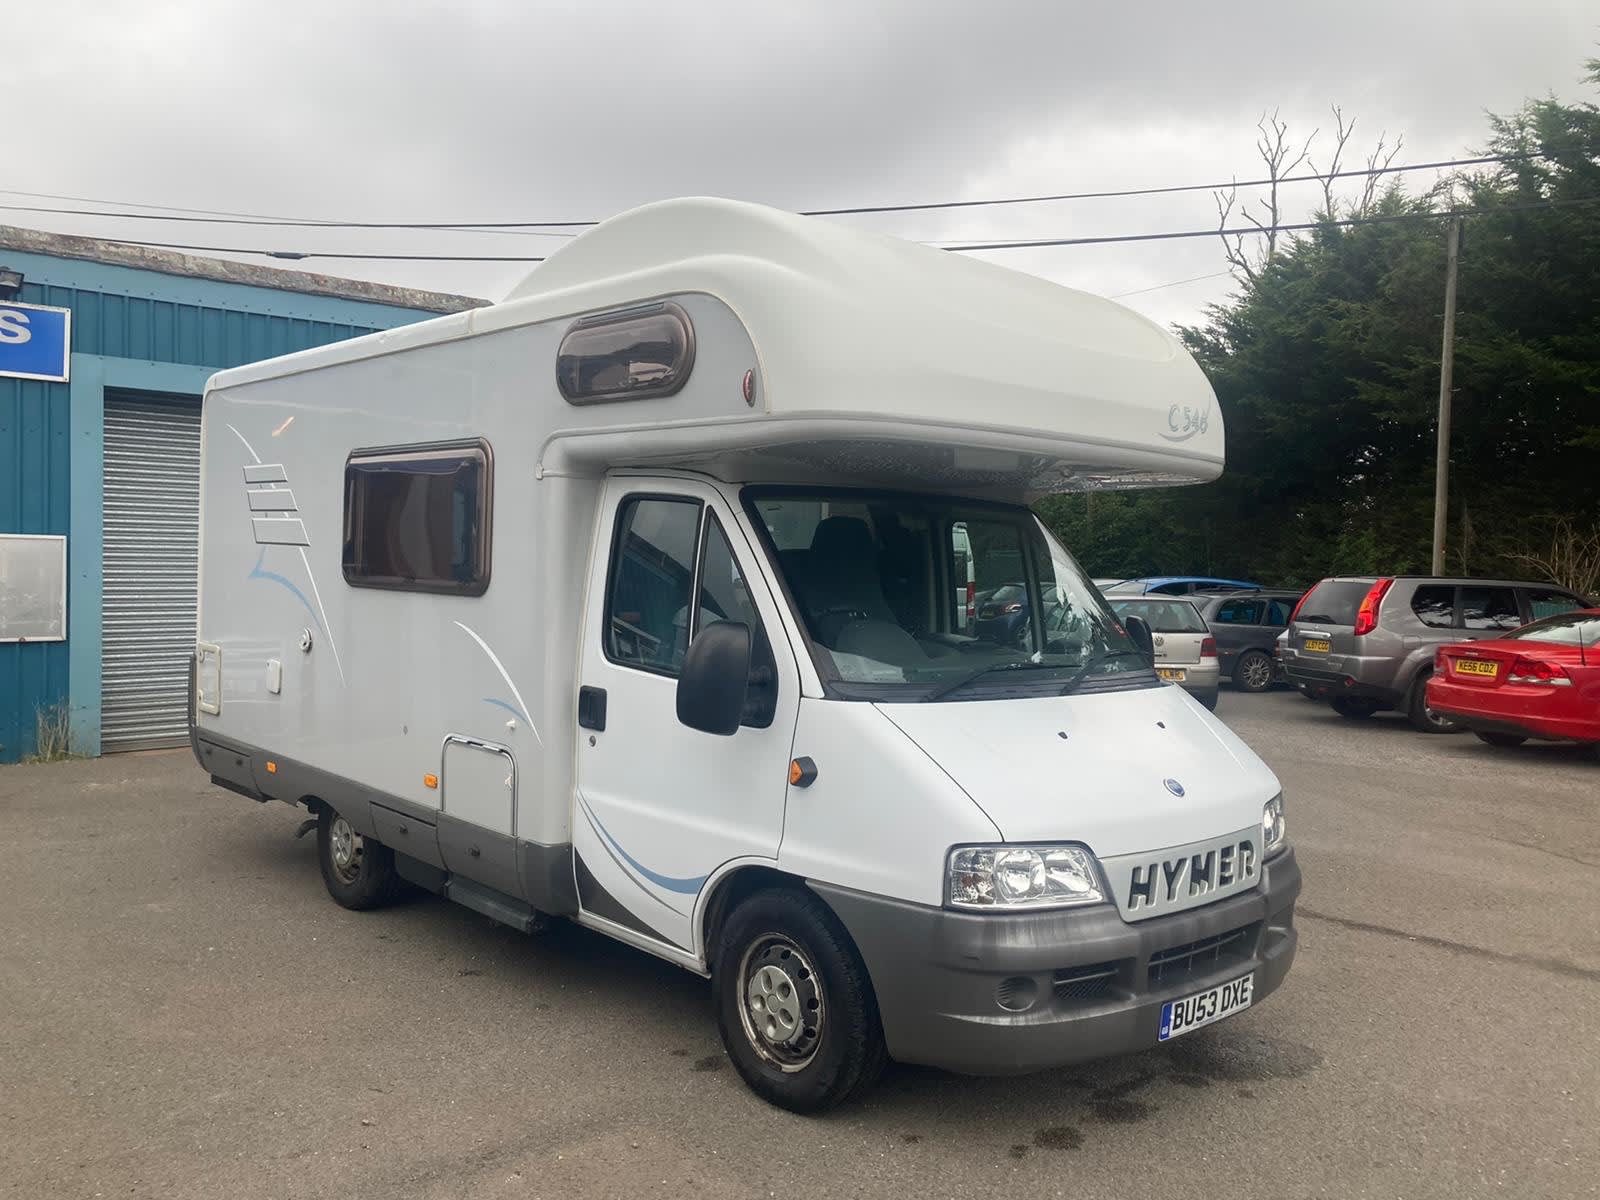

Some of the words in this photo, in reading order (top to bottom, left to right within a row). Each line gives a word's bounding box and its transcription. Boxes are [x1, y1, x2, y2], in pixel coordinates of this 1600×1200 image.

[1168, 403, 1181, 432] C
[1478, 662, 1495, 673] CDZ
[1128, 839, 1256, 912] HYMER
[1172, 990, 1218, 1030] BU53
[1220, 976, 1250, 1012] DXE
